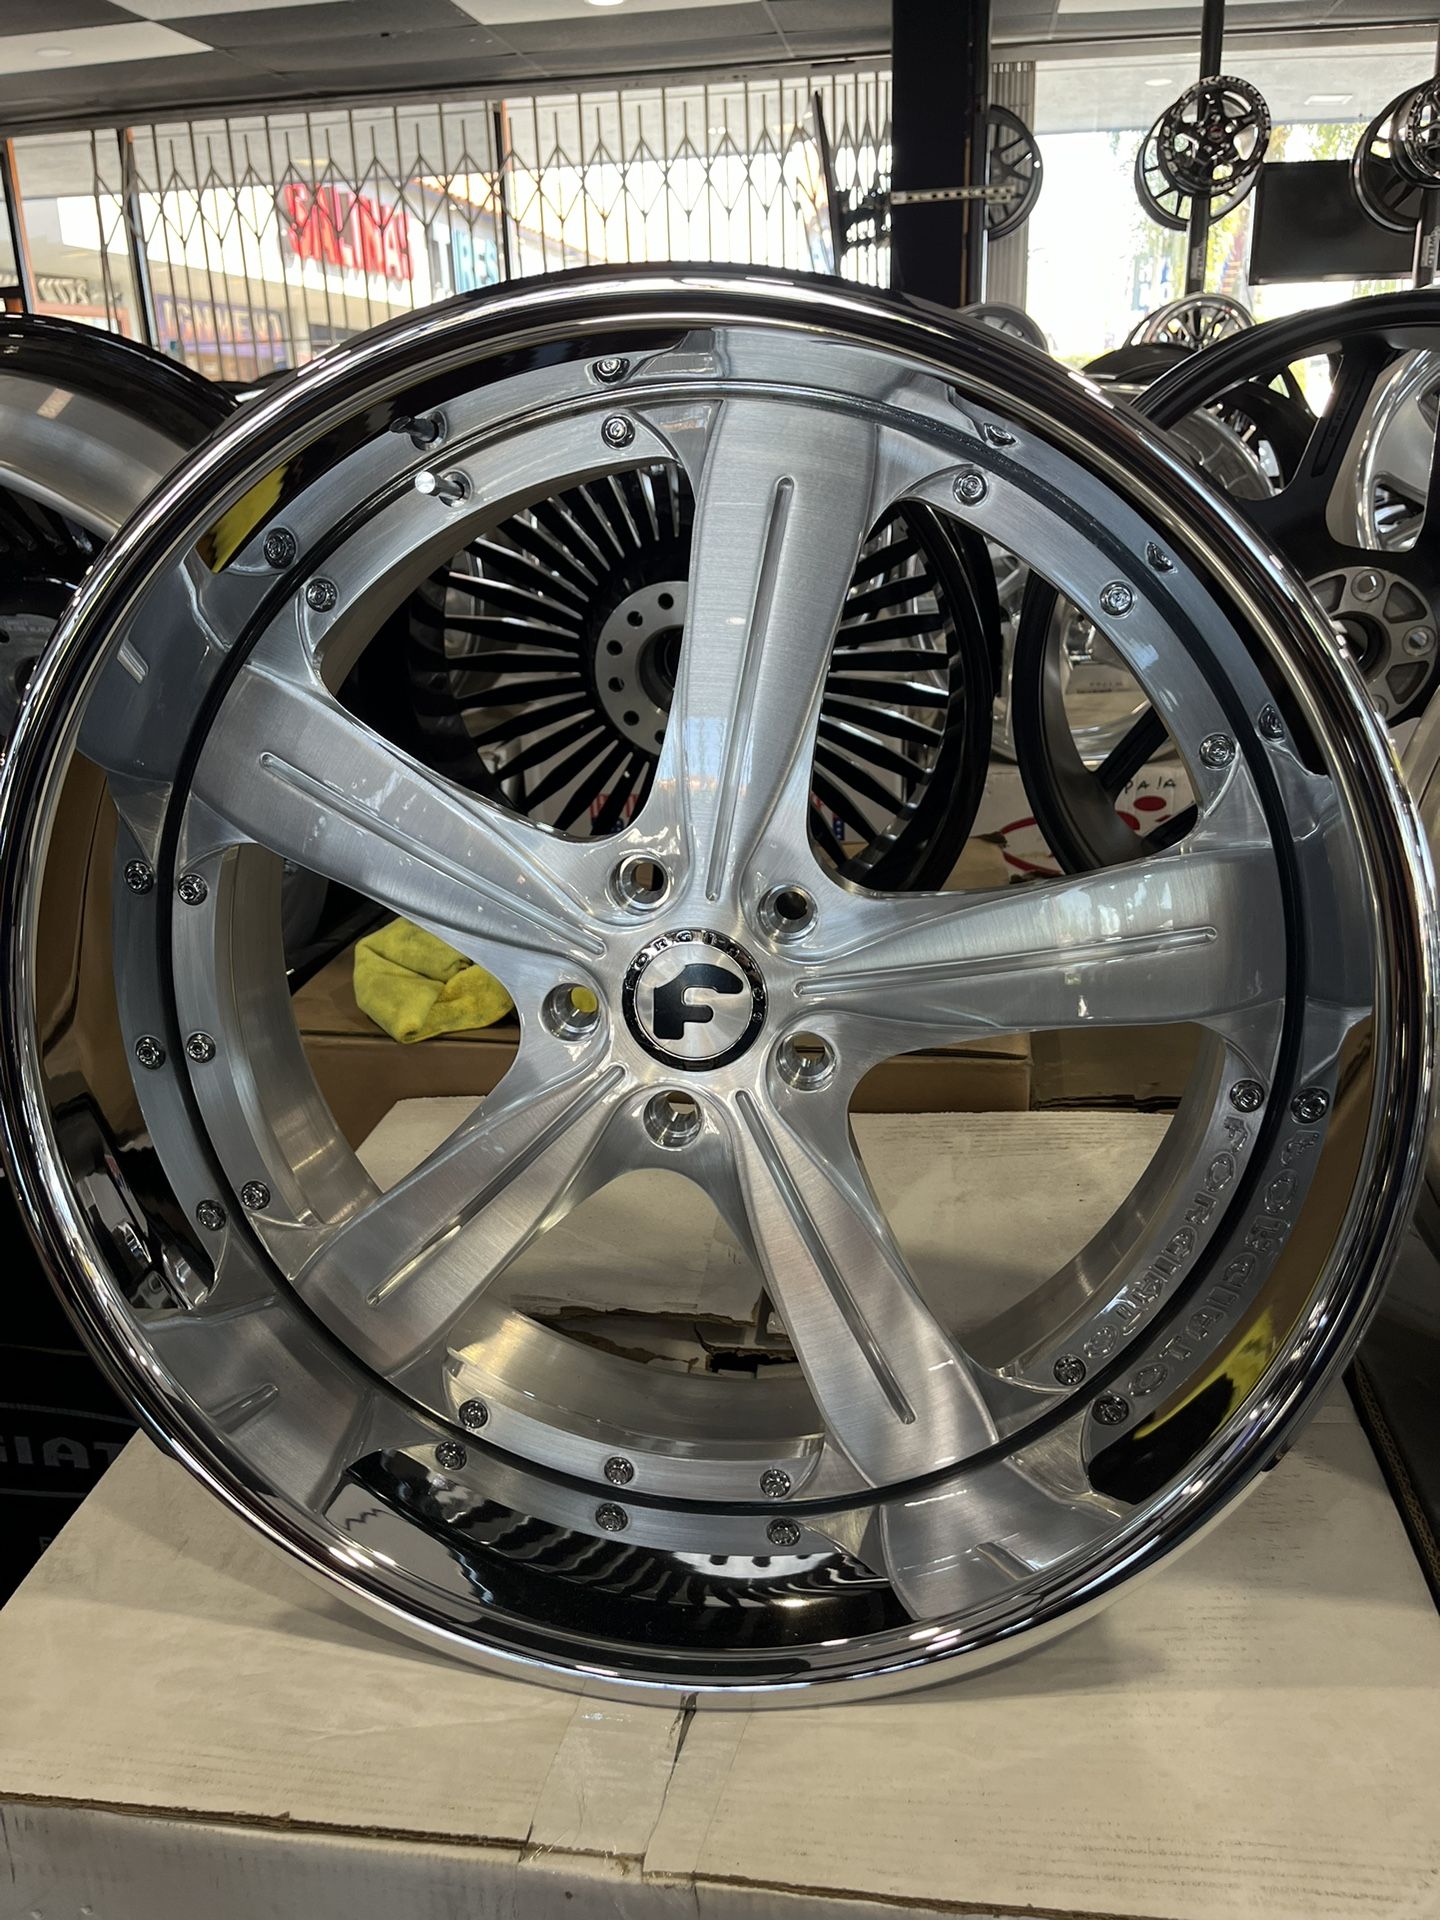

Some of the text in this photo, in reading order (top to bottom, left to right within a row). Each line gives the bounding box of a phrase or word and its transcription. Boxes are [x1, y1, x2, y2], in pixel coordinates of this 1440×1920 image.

[160, 299, 282, 343] IGNMENT
[1083, 1113, 1253, 1361] FORGIATO
[1128, 1130, 1320, 1398] FORGIATO
[0, 1434, 123, 1470] IAT
